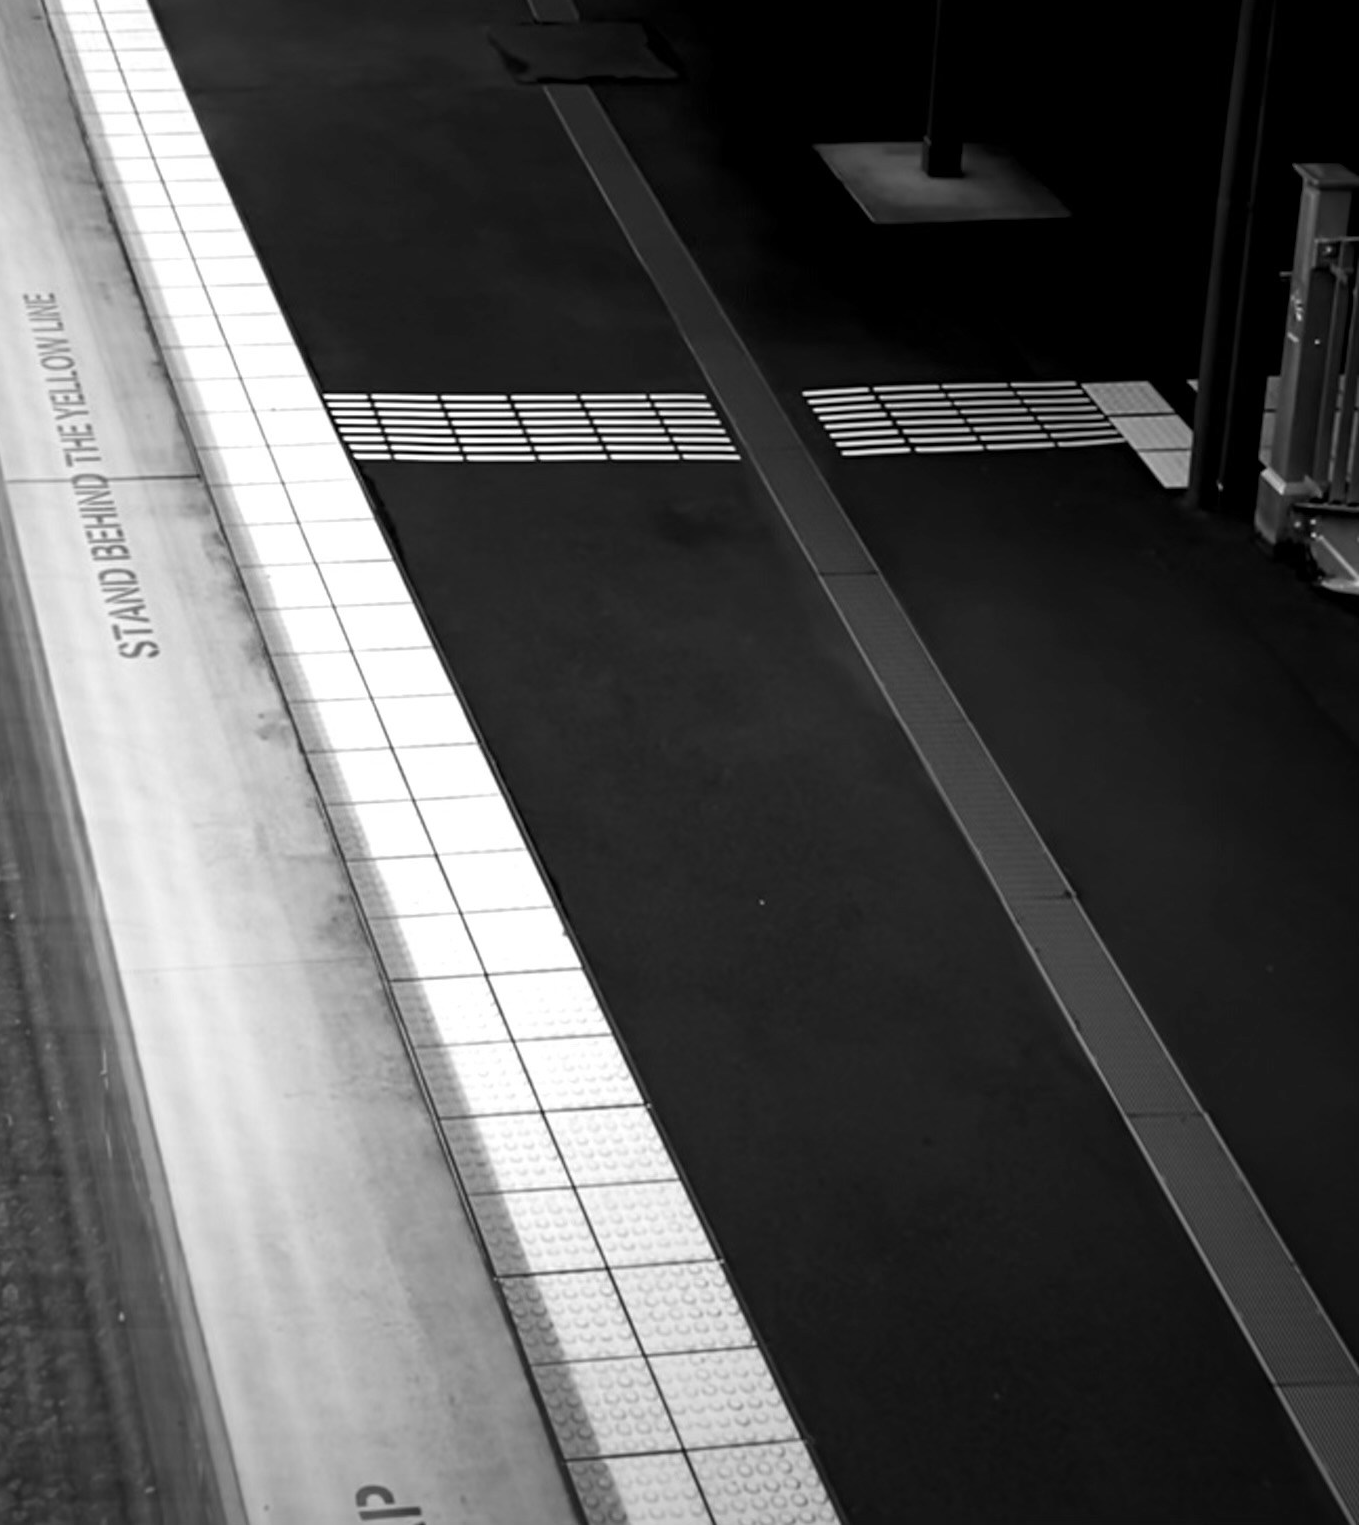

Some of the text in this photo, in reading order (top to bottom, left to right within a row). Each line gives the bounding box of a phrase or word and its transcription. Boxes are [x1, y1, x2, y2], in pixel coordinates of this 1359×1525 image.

[23, 292, 160, 659] STAND BEHIND THE YELLOW LINE
